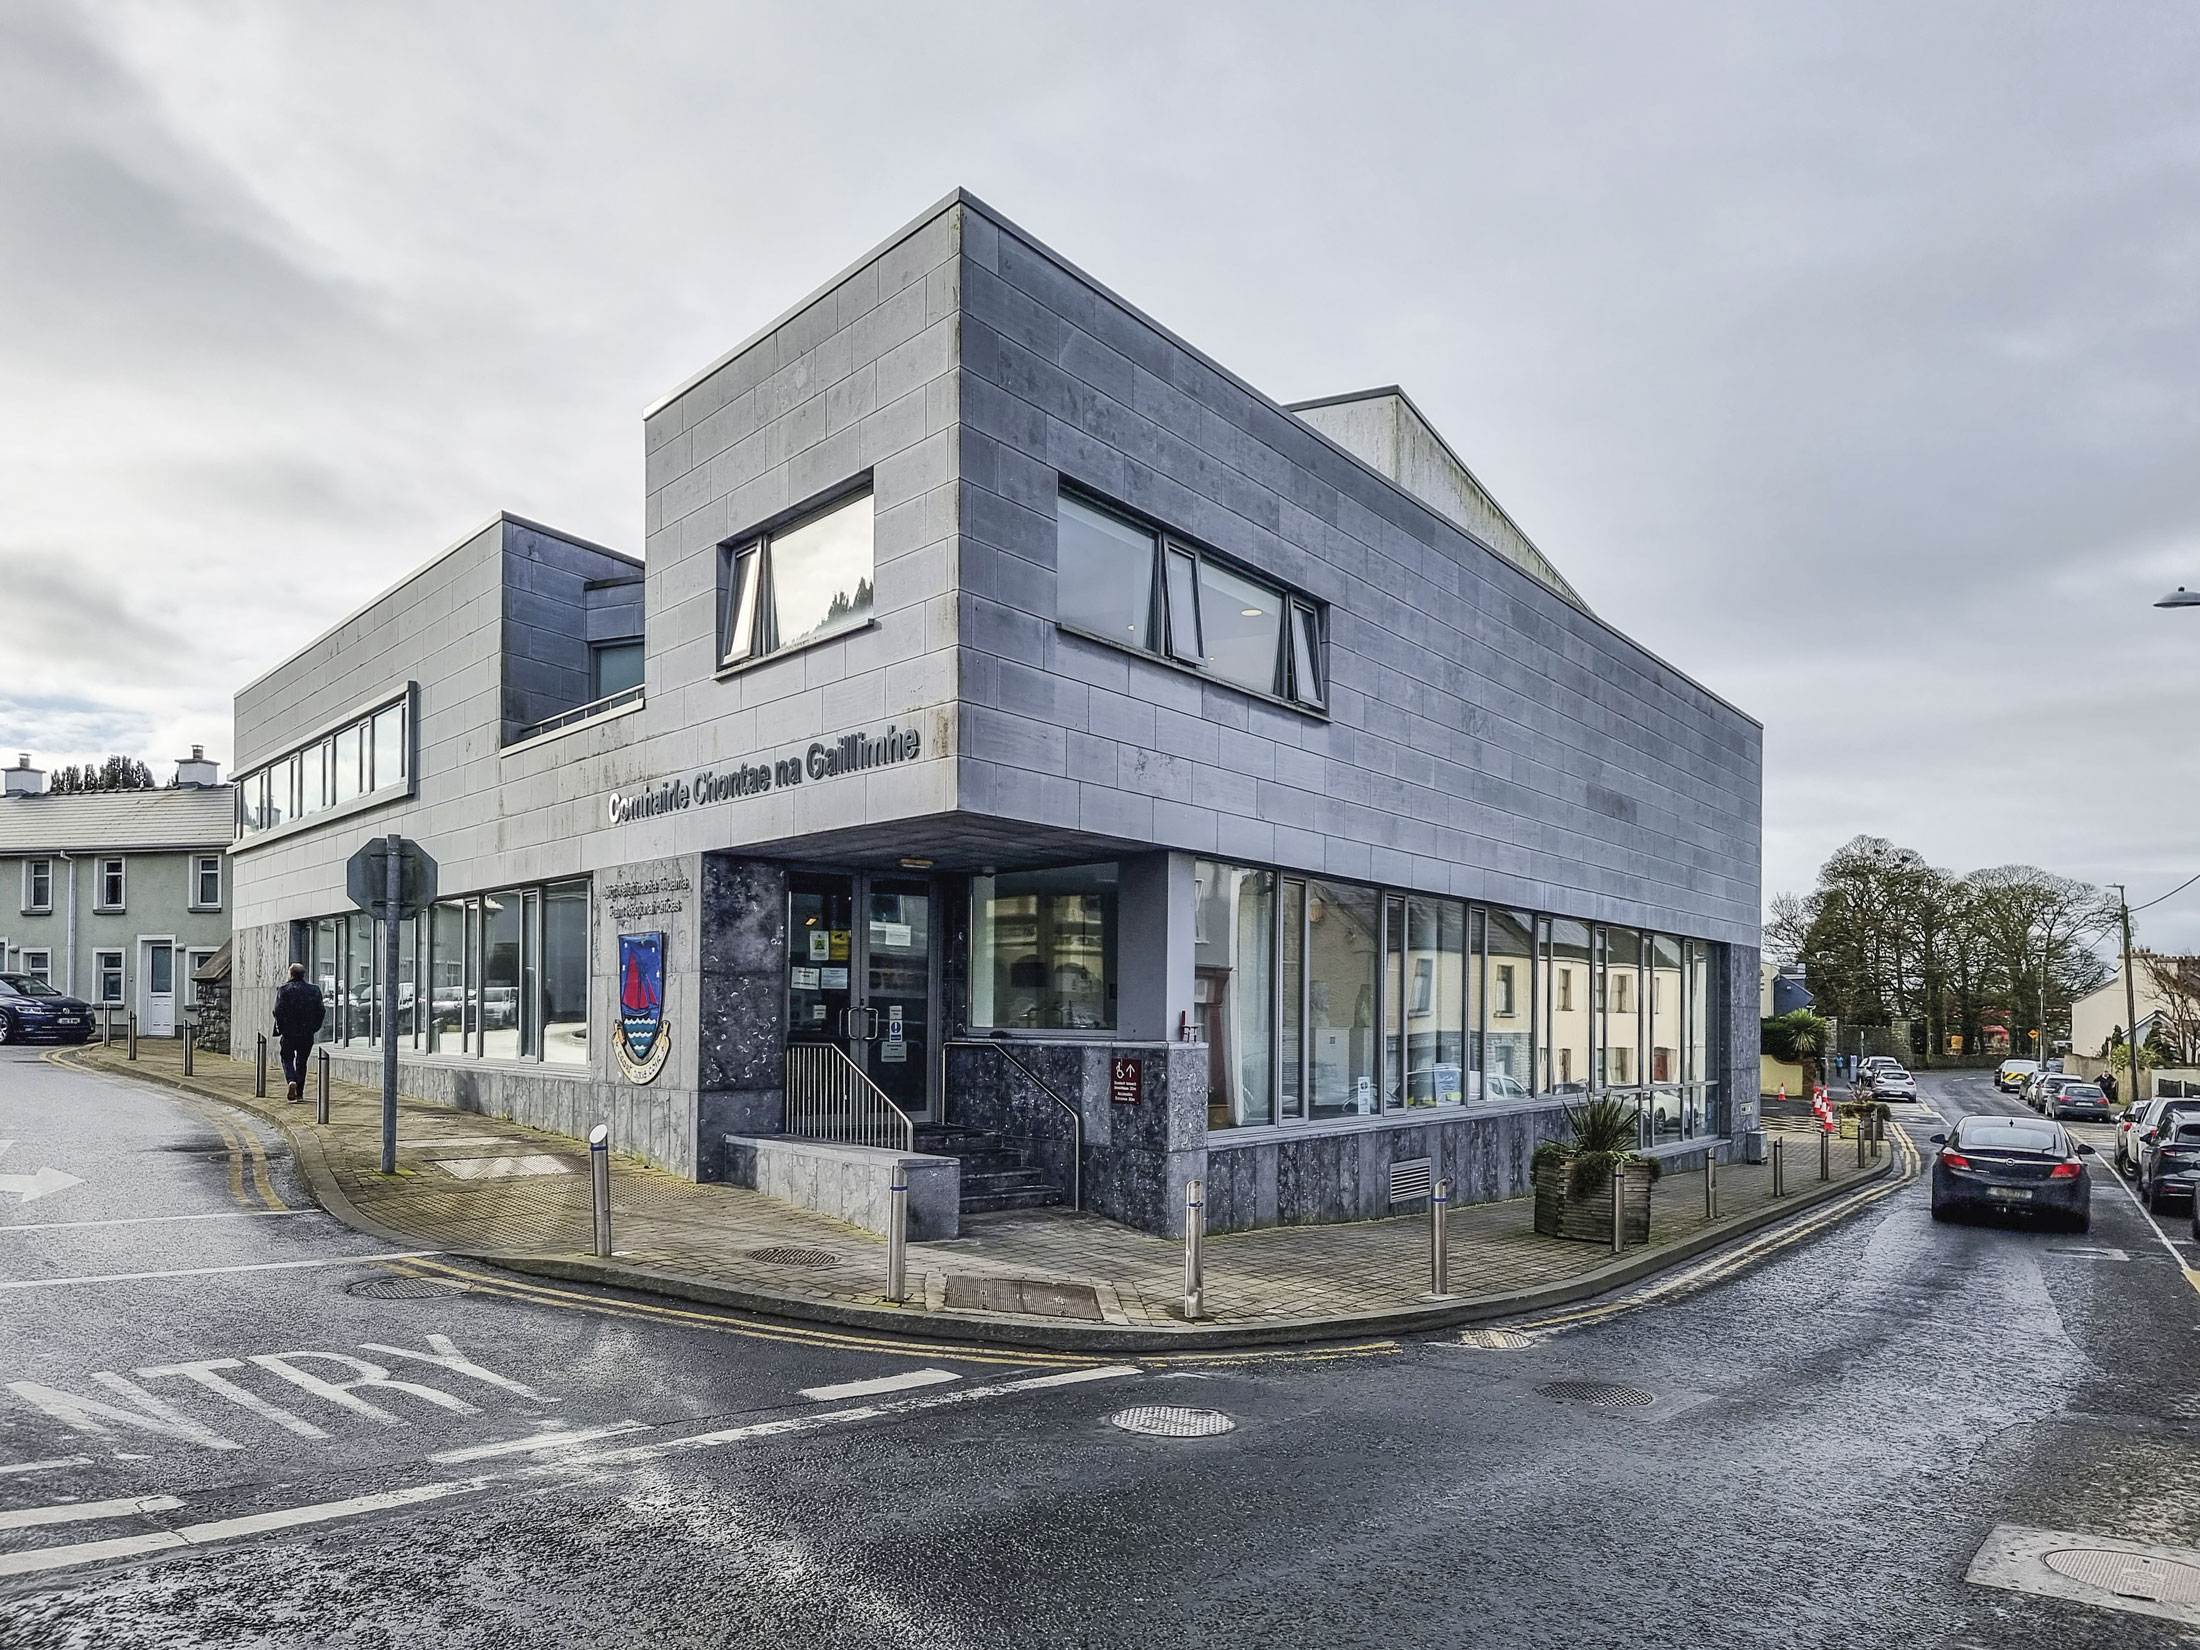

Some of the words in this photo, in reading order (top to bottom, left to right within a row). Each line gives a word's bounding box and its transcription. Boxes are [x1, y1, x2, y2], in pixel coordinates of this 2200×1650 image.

[608, 780, 690, 825] Comhairle
[692, 761, 771, 805] Chontae
[775, 756, 802, 786] na
[806, 724, 921, 778] Gaillimhe
